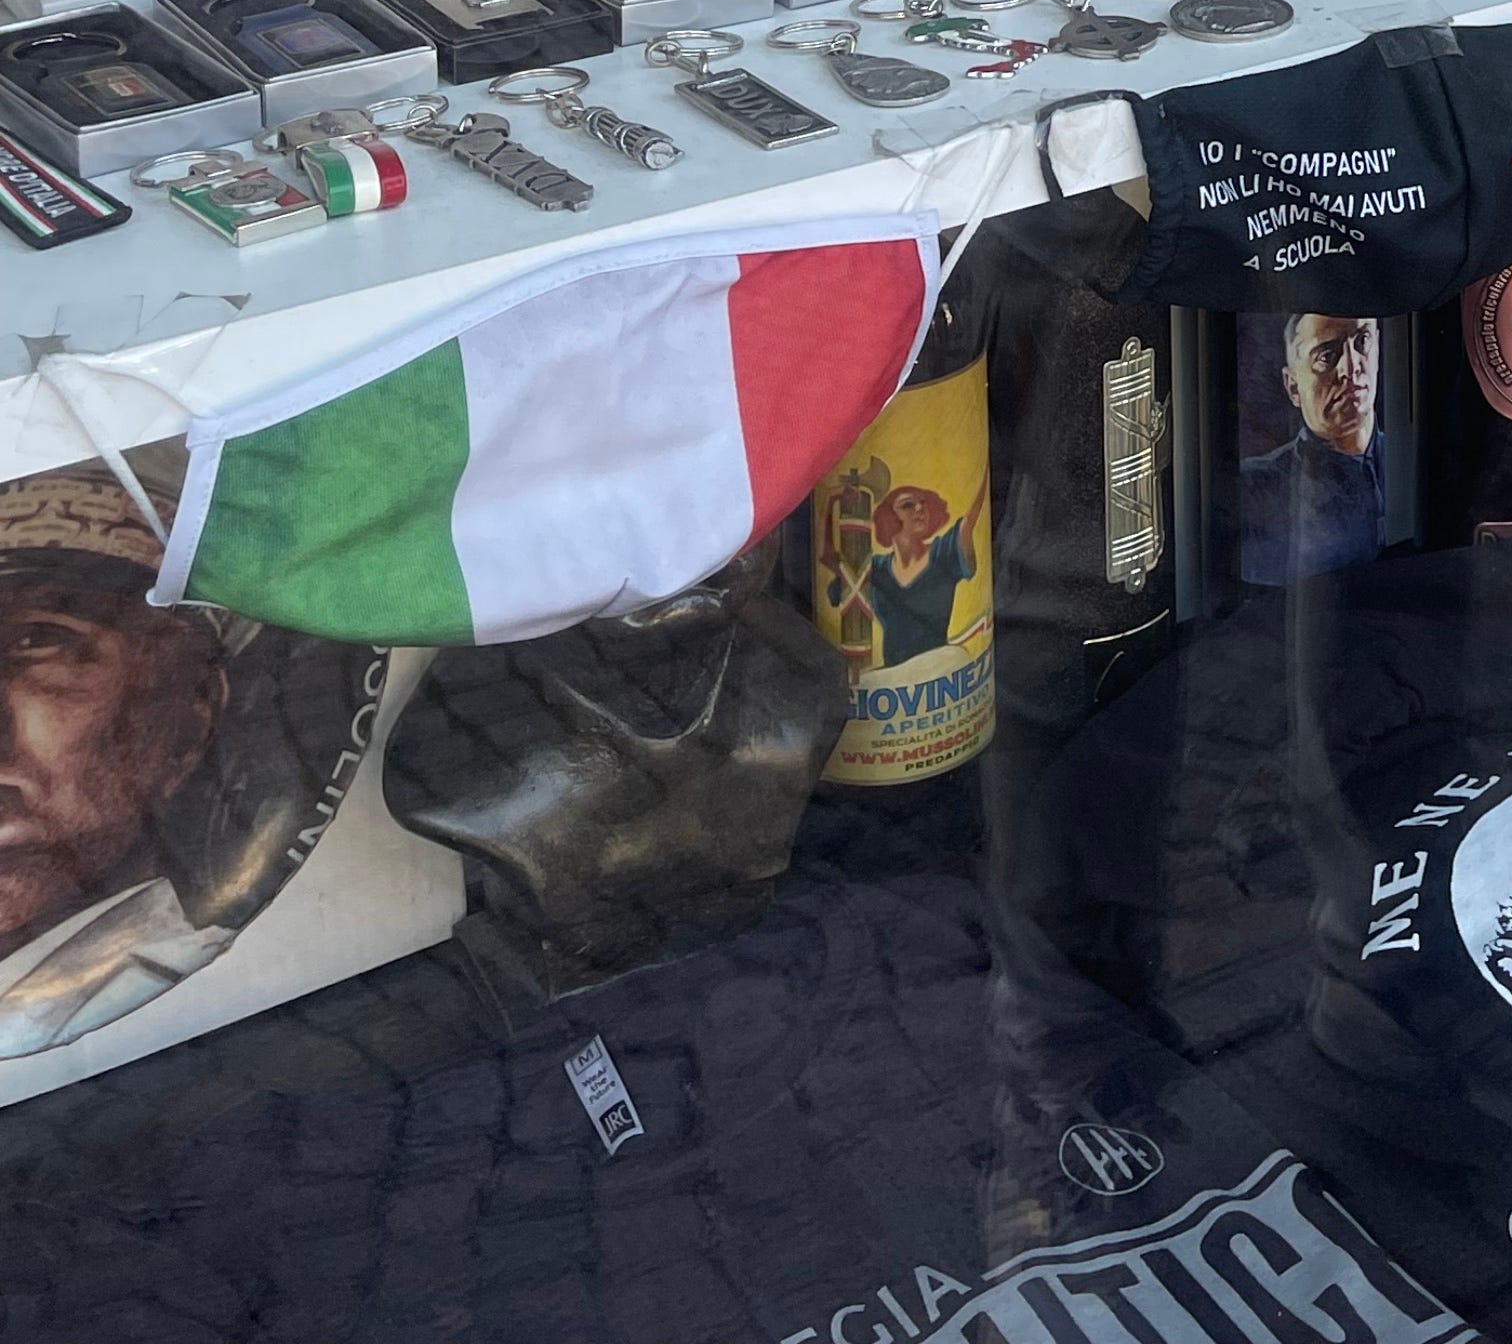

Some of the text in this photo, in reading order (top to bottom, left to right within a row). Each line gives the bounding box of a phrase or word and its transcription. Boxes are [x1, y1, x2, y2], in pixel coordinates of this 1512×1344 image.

[715, 83, 780, 120] DUX
[1234, 143, 1242, 161] I
[1199, 173, 1427, 218] NON LI HO MAI AVUTI
[1246, 203, 1366, 242] NEMMENO
[1242, 234, 1356, 272] A SCUOLA
[904, 736, 980, 772] PREDAPPIO
[1361, 772, 1501, 961] ME NE
[577, 1047, 595, 1067] M
[604, 1103, 633, 1137] JRC
[781, 1265, 972, 1344] GIA
